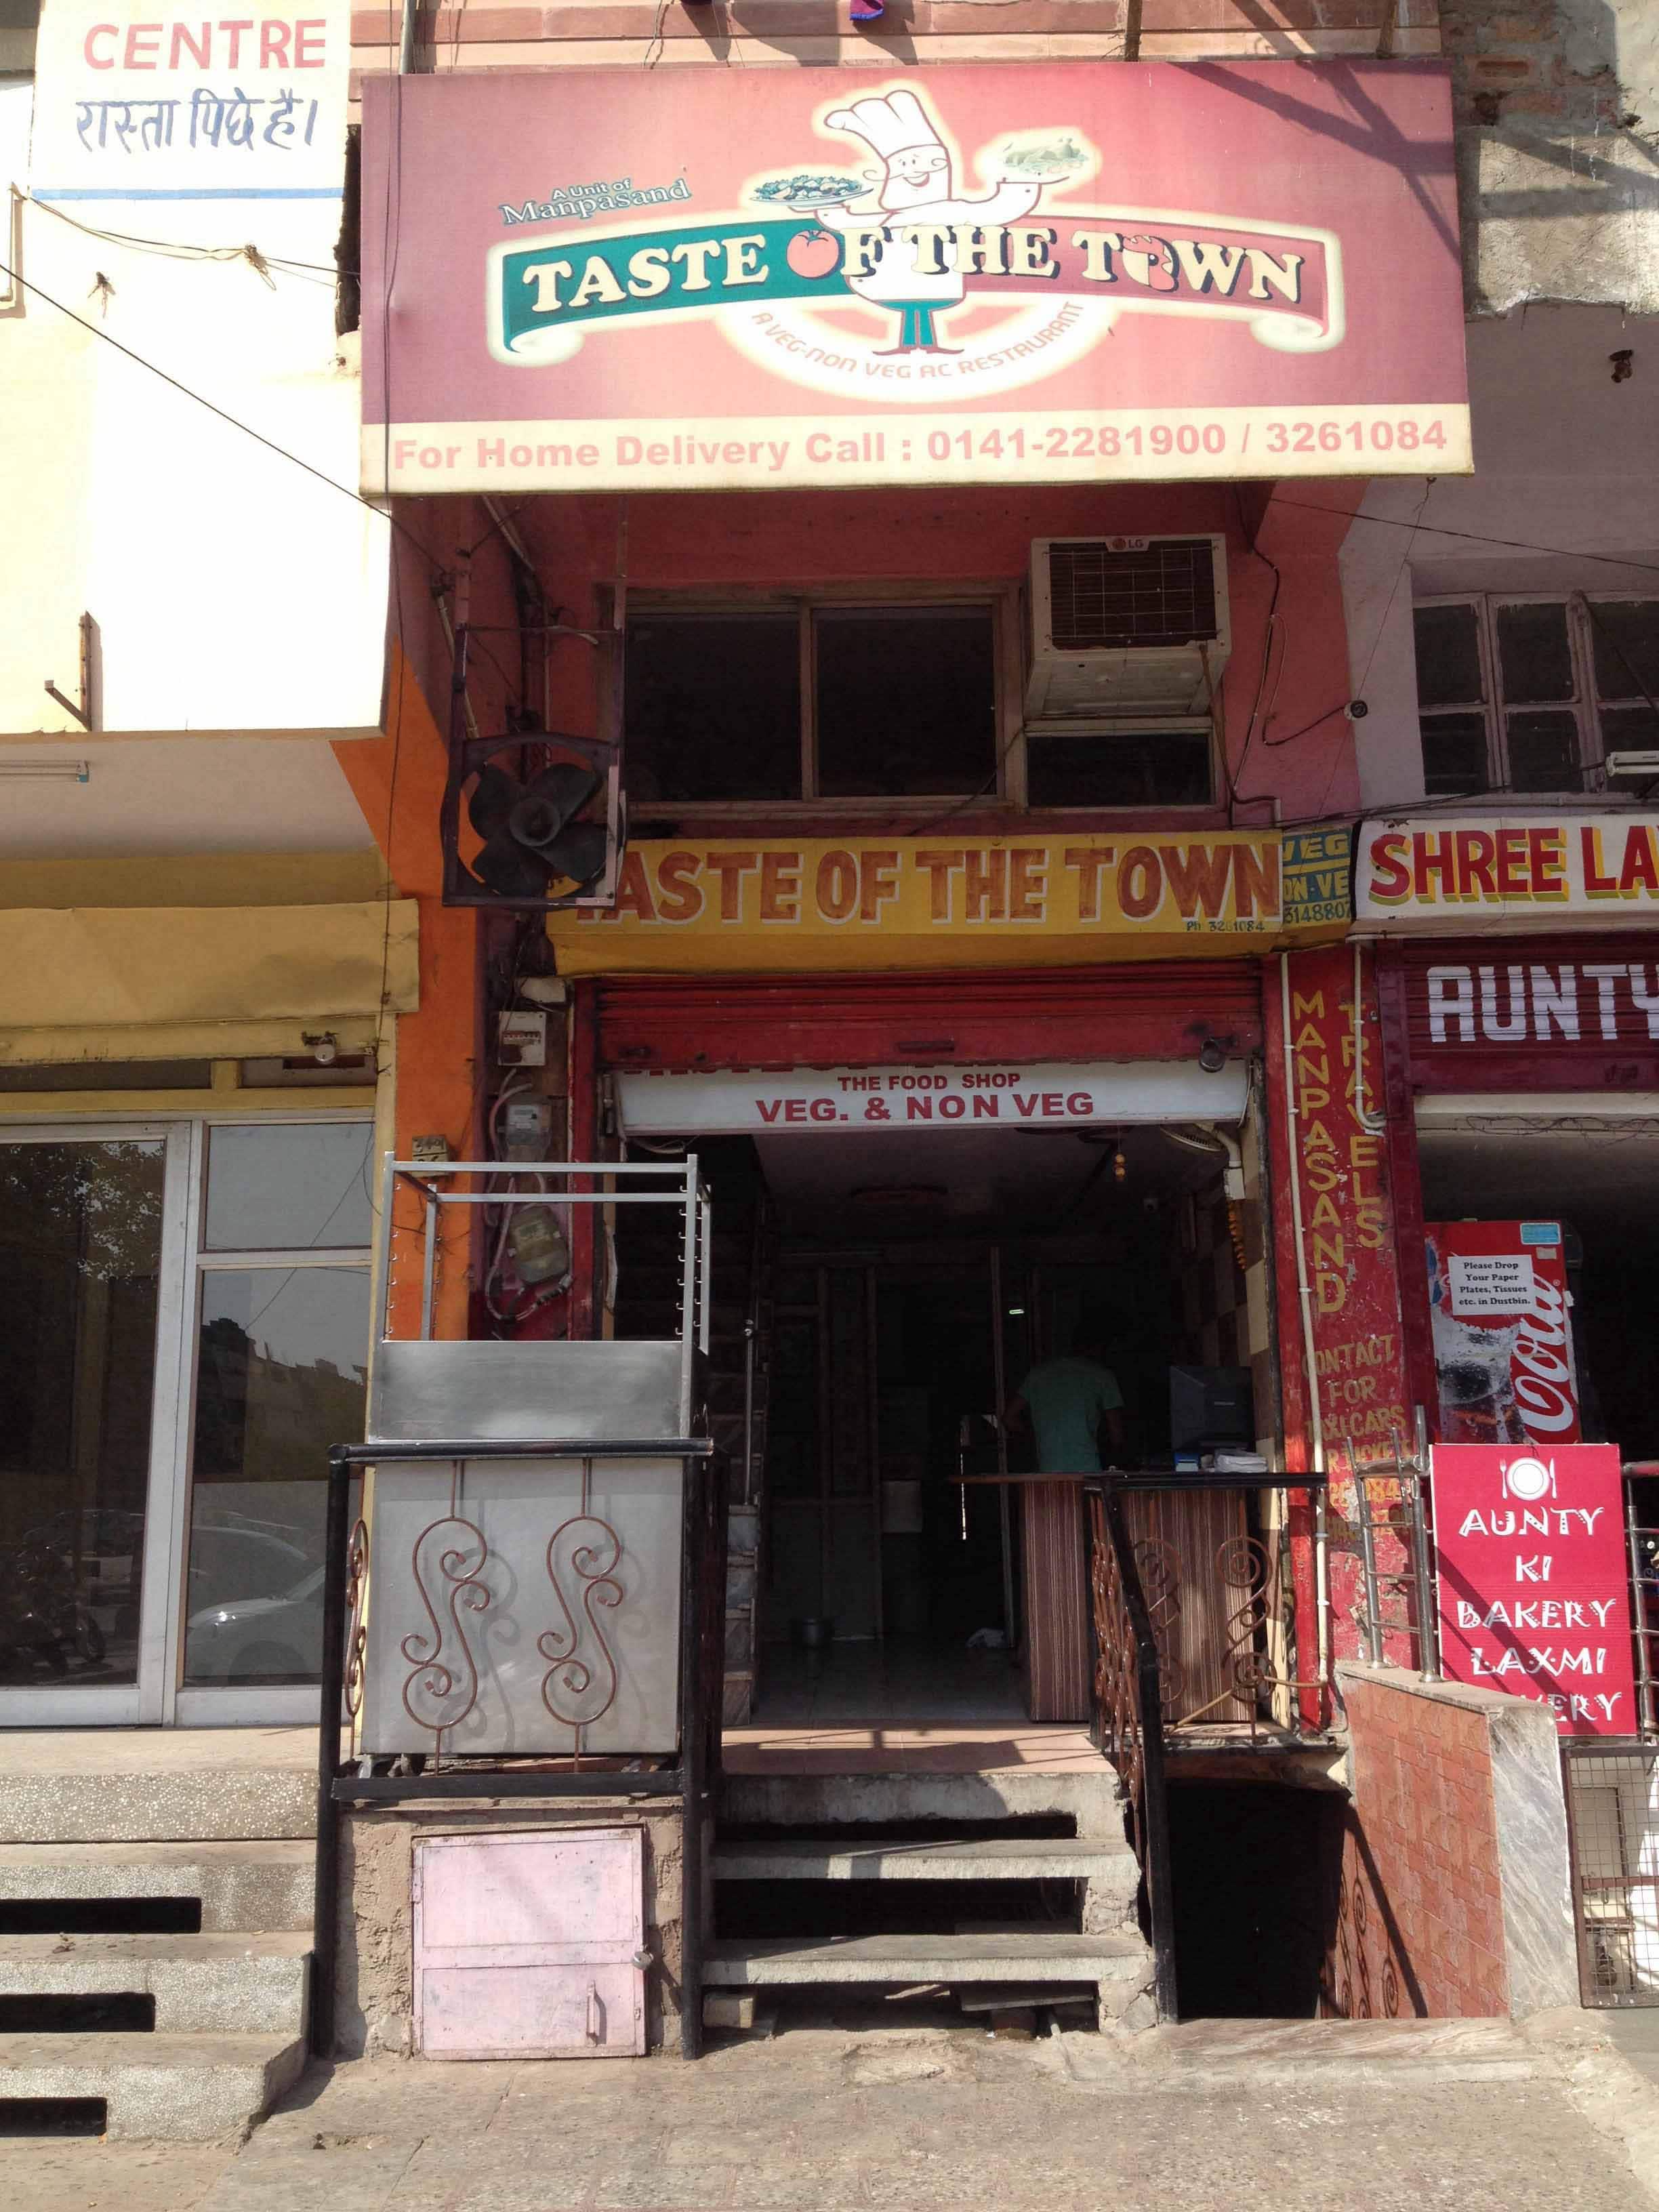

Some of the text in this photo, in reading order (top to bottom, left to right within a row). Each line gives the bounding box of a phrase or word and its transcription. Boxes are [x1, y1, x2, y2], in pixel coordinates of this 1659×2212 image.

[83, 19, 327, 70] CENTRE
[75, 99, 181, 154] रास्ता
[499, 178, 691, 226] Manpasand
[552, 179, 632, 201] A Unit of
[523, 234, 769, 313] TASTE
[901, 224, 1059, 279] THE
[1071, 230, 1305, 304] TOWN
[865, 363, 912, 379] VEG
[394, 439, 462, 470] For
[476, 436, 600, 469] Home
[616, 434, 790, 471] Delivery
[805, 431, 884, 464] Call
[928, 424, 1226, 462] 0141-2281900
[1267, 419, 1447, 453] 3261084
[1128, 537, 1144, 548] LG
[1369, 825, 1659, 907] SHREE LA
[577, 842, 1282, 924] ASTE OF THE TOWN
[838, 1073, 1021, 1092] THE FOOD SHOP
[755, 1092, 1094, 1122] VEG. & NON VEG
[1463, 1261, 1519, 1270] Please Drop
[1465, 1273, 1519, 1282] Your Paper
[1458, 1296, 1531, 1306] etc. in Dustbin.
[1460, 1285, 1528, 1294] Plates, Tissues
[1327, 1376, 1378, 1408] FOR
[1458, 1507, 1605, 1537] AUNTY
[1515, 1555, 1552, 1582] KI
[1457, 1598, 1616, 1629] BAKERY
[1470, 1647, 1607, 1677] LAXMI
